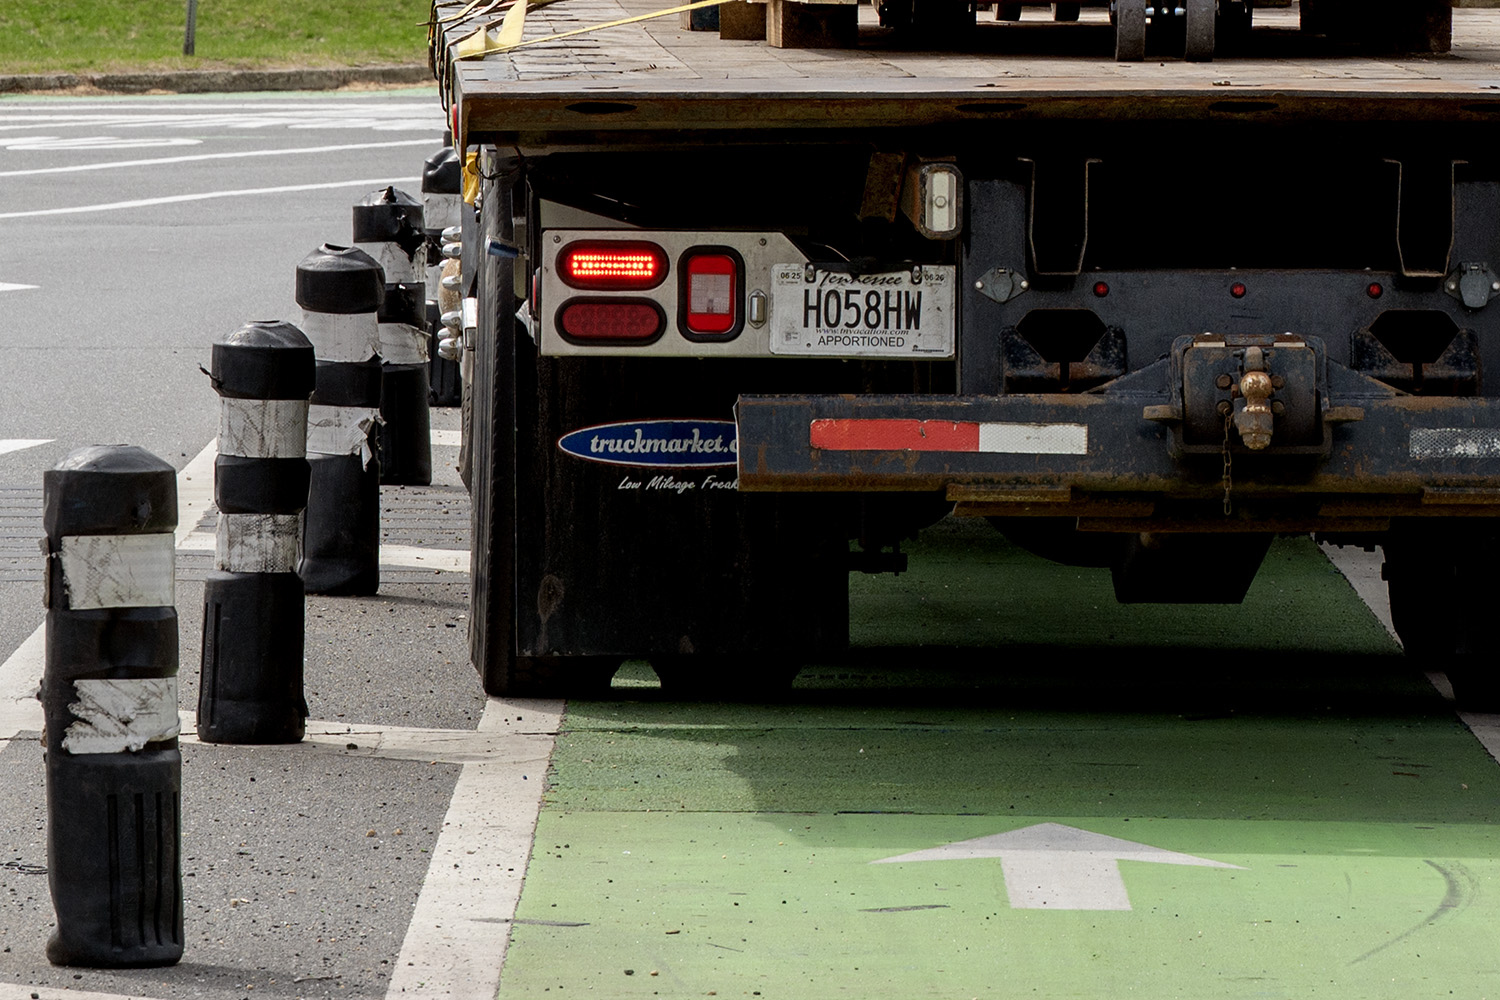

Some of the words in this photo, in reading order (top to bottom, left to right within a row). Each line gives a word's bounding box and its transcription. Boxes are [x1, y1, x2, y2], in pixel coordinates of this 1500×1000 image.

[819, 270, 903, 287] Tennessee
[816, 328, 910, 336] www.tnvacation.com
[818, 336, 905, 348] APPORTIONED
[618, 476, 641, 490] Low
[646, 475, 696, 494] Mileage
